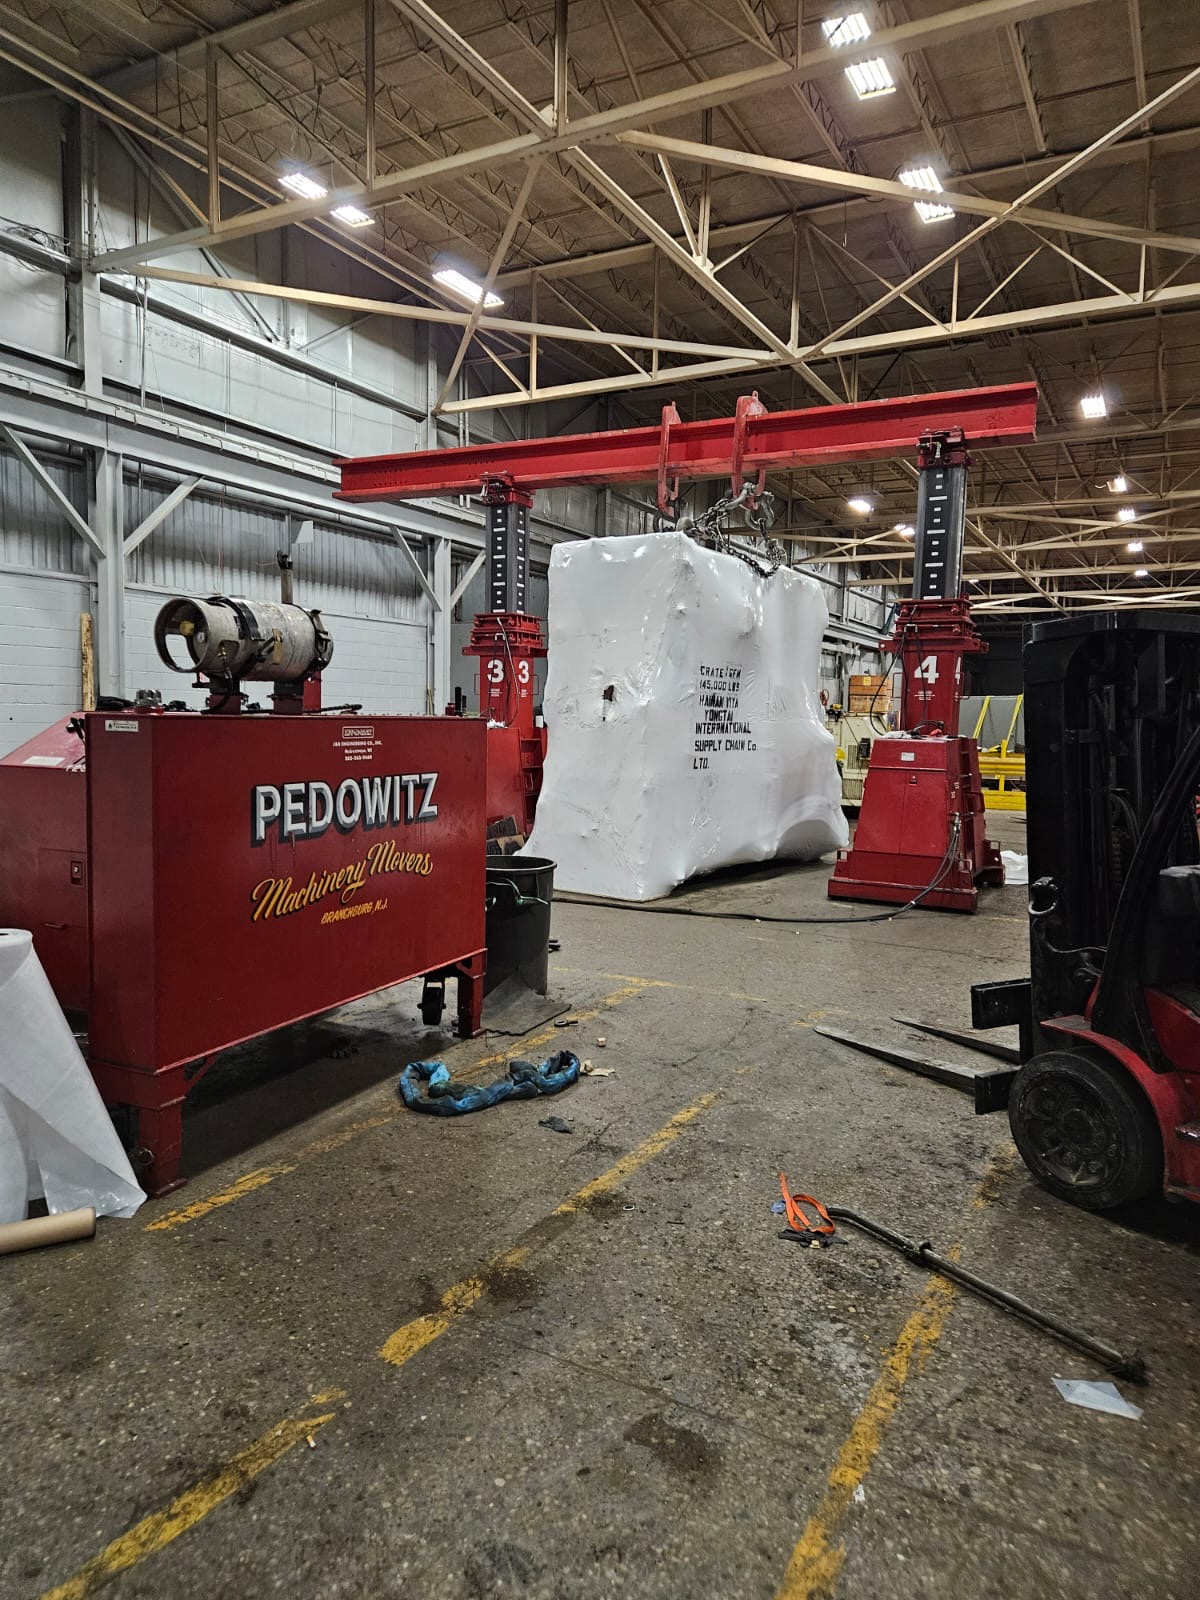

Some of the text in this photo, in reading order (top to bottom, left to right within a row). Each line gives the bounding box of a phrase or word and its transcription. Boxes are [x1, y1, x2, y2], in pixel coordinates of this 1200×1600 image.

[487, 659, 504, 683] 3
[518, 660, 530, 684] 3
[700, 665, 724, 678] CRATE
[914, 655, 940, 684] 4
[699, 679, 740, 692] 145,000 LBS
[704, 709, 734, 722] YONGTAI
[694, 739, 722, 752] SUPPLY
[725, 739, 746, 751] CHAIN
[693, 757, 710, 770] LTD.
[254, 772, 439, 843] PEDOWITZ
[252, 839, 433, 921] Machinery Movers
